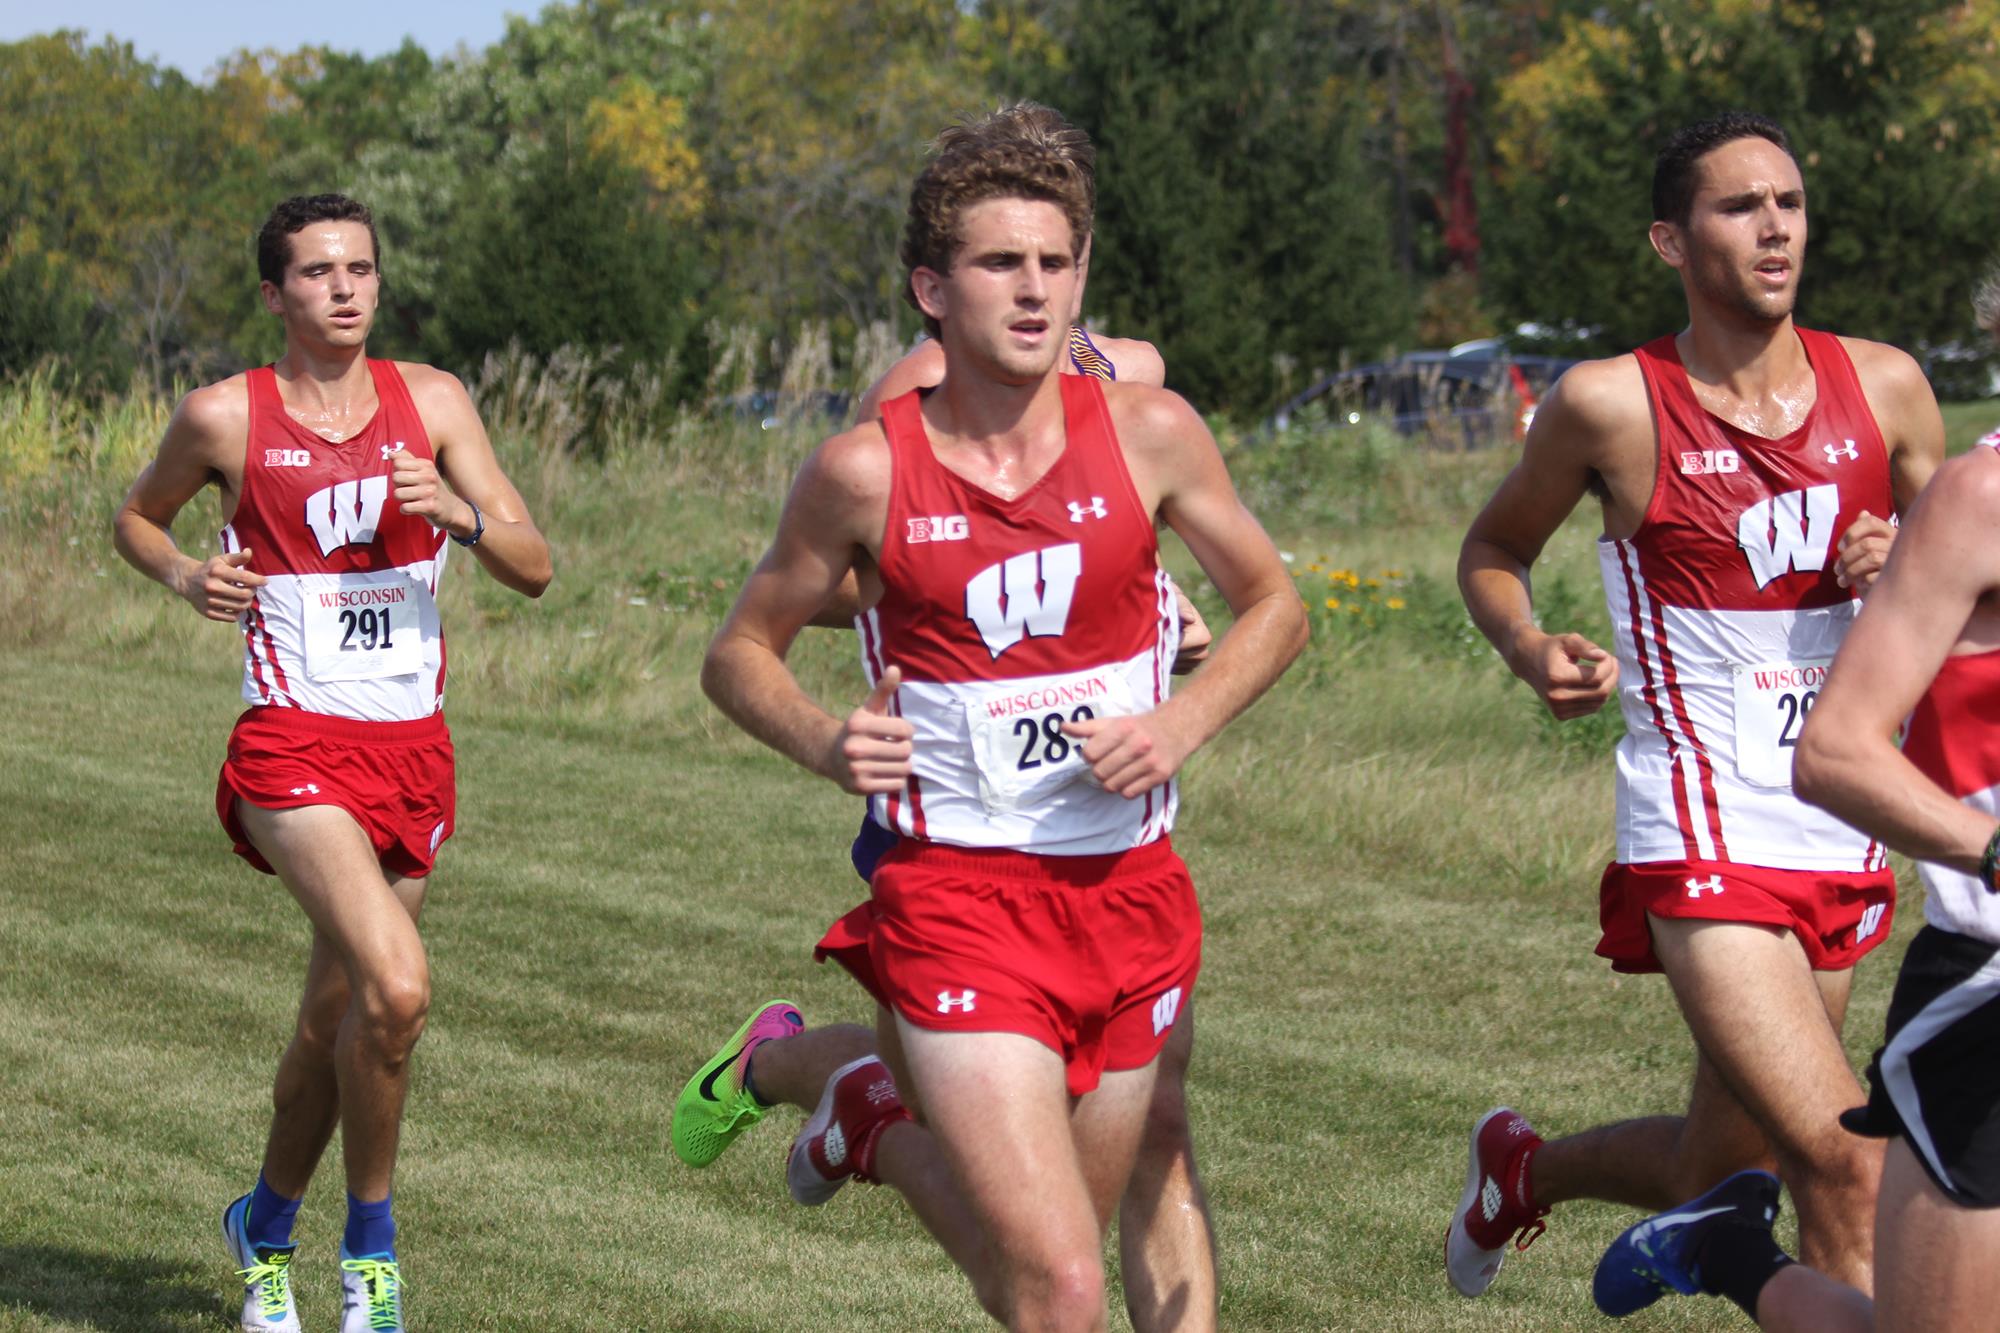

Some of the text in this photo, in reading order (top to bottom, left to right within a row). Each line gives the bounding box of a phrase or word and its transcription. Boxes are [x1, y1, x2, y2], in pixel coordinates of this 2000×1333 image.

[304, 475, 388, 559] W
[1738, 484, 1840, 592] W
[319, 587, 405, 608] WISCONSIN
[338, 607, 393, 652] 291
[965, 543, 1082, 662] W
[987, 675, 1108, 718] WISCONSIN
